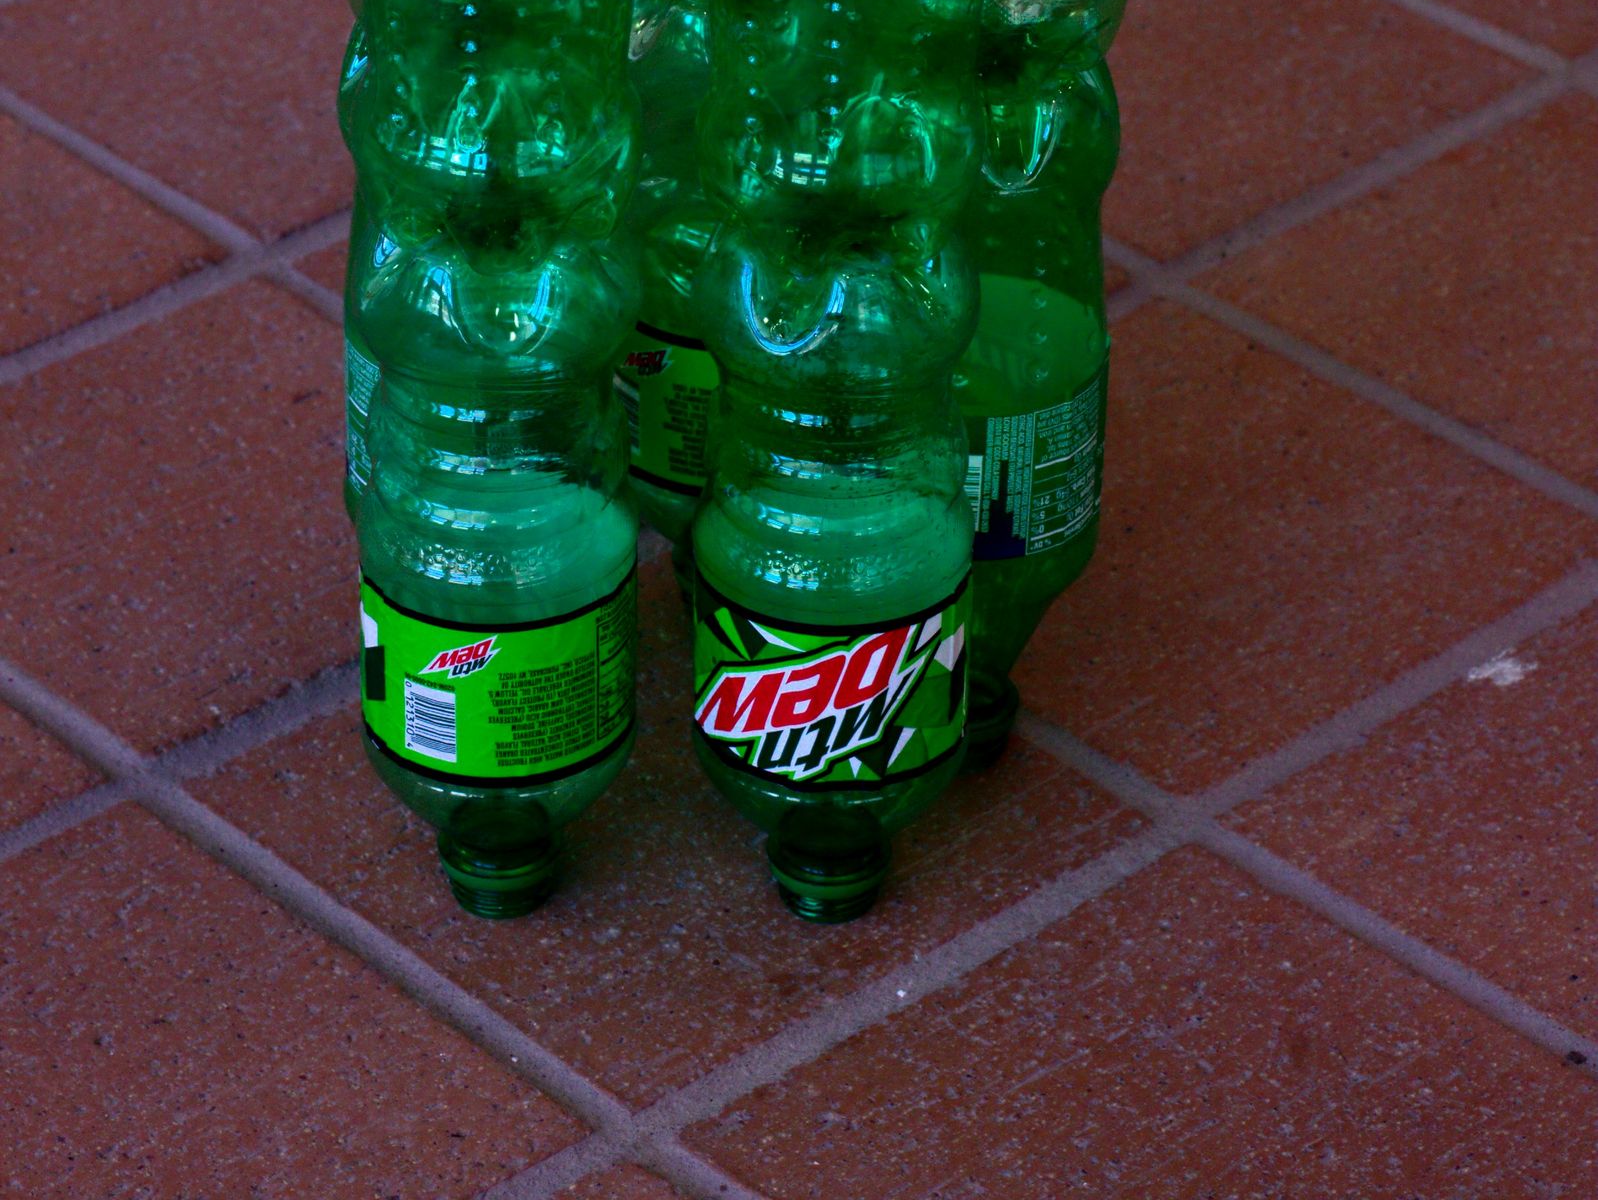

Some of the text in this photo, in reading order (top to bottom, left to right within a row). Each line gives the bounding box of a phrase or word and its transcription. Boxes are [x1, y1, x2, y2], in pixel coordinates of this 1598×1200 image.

[452, 654, 492, 676] Mtn
[697, 624, 911, 733] Dew
[757, 666, 918, 773] Mtn
